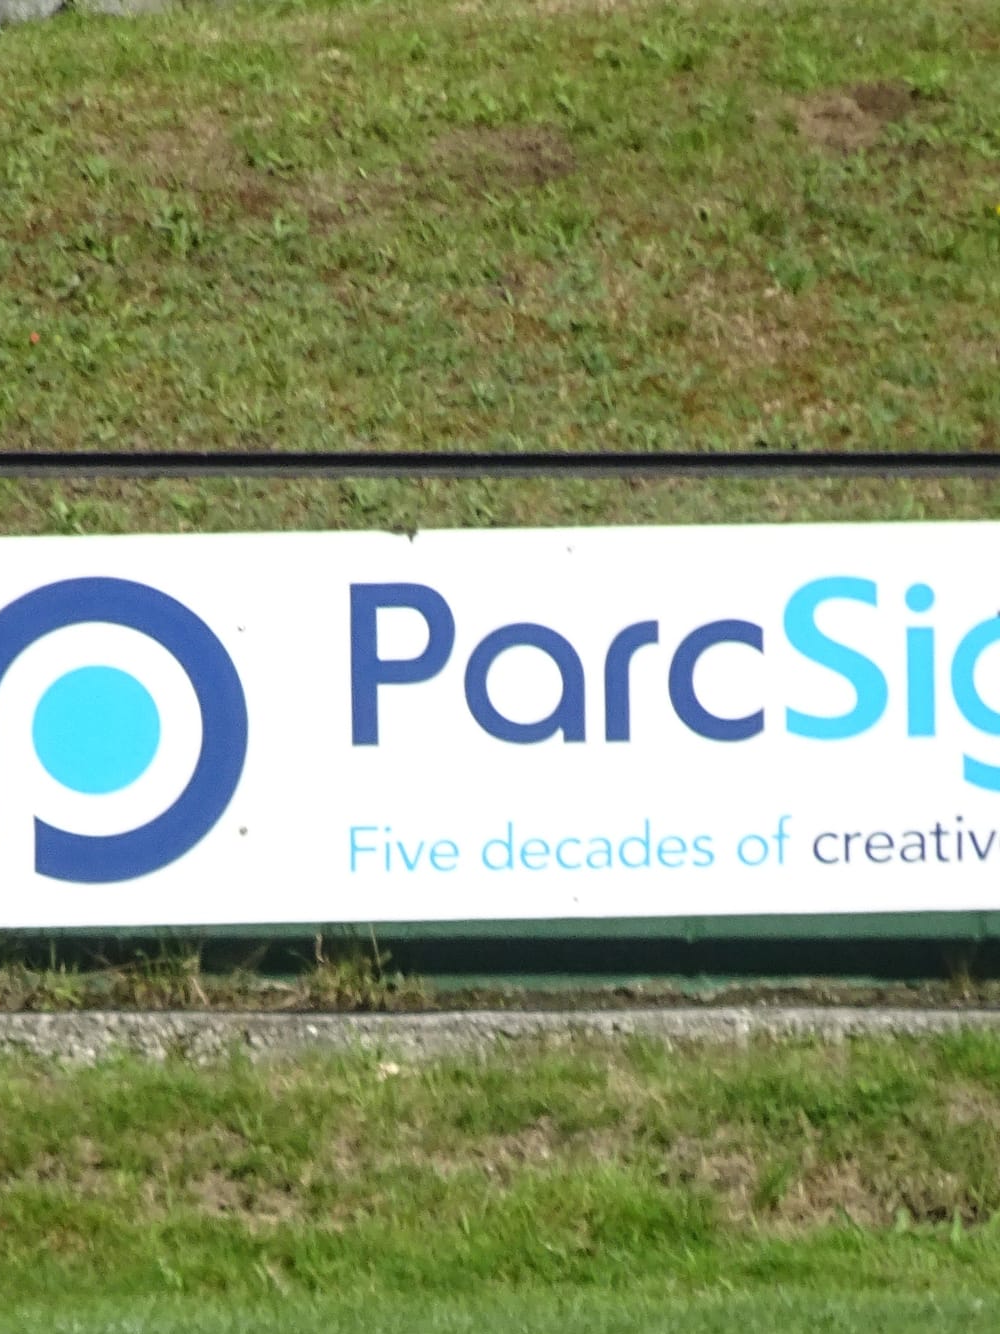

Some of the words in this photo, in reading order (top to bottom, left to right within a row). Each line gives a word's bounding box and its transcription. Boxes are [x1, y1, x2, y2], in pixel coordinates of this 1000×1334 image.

[349, 825, 461, 874] Five
[481, 818, 717, 873] decades
[737, 814, 793, 868] of
[812, 815, 1000, 866] creativ
